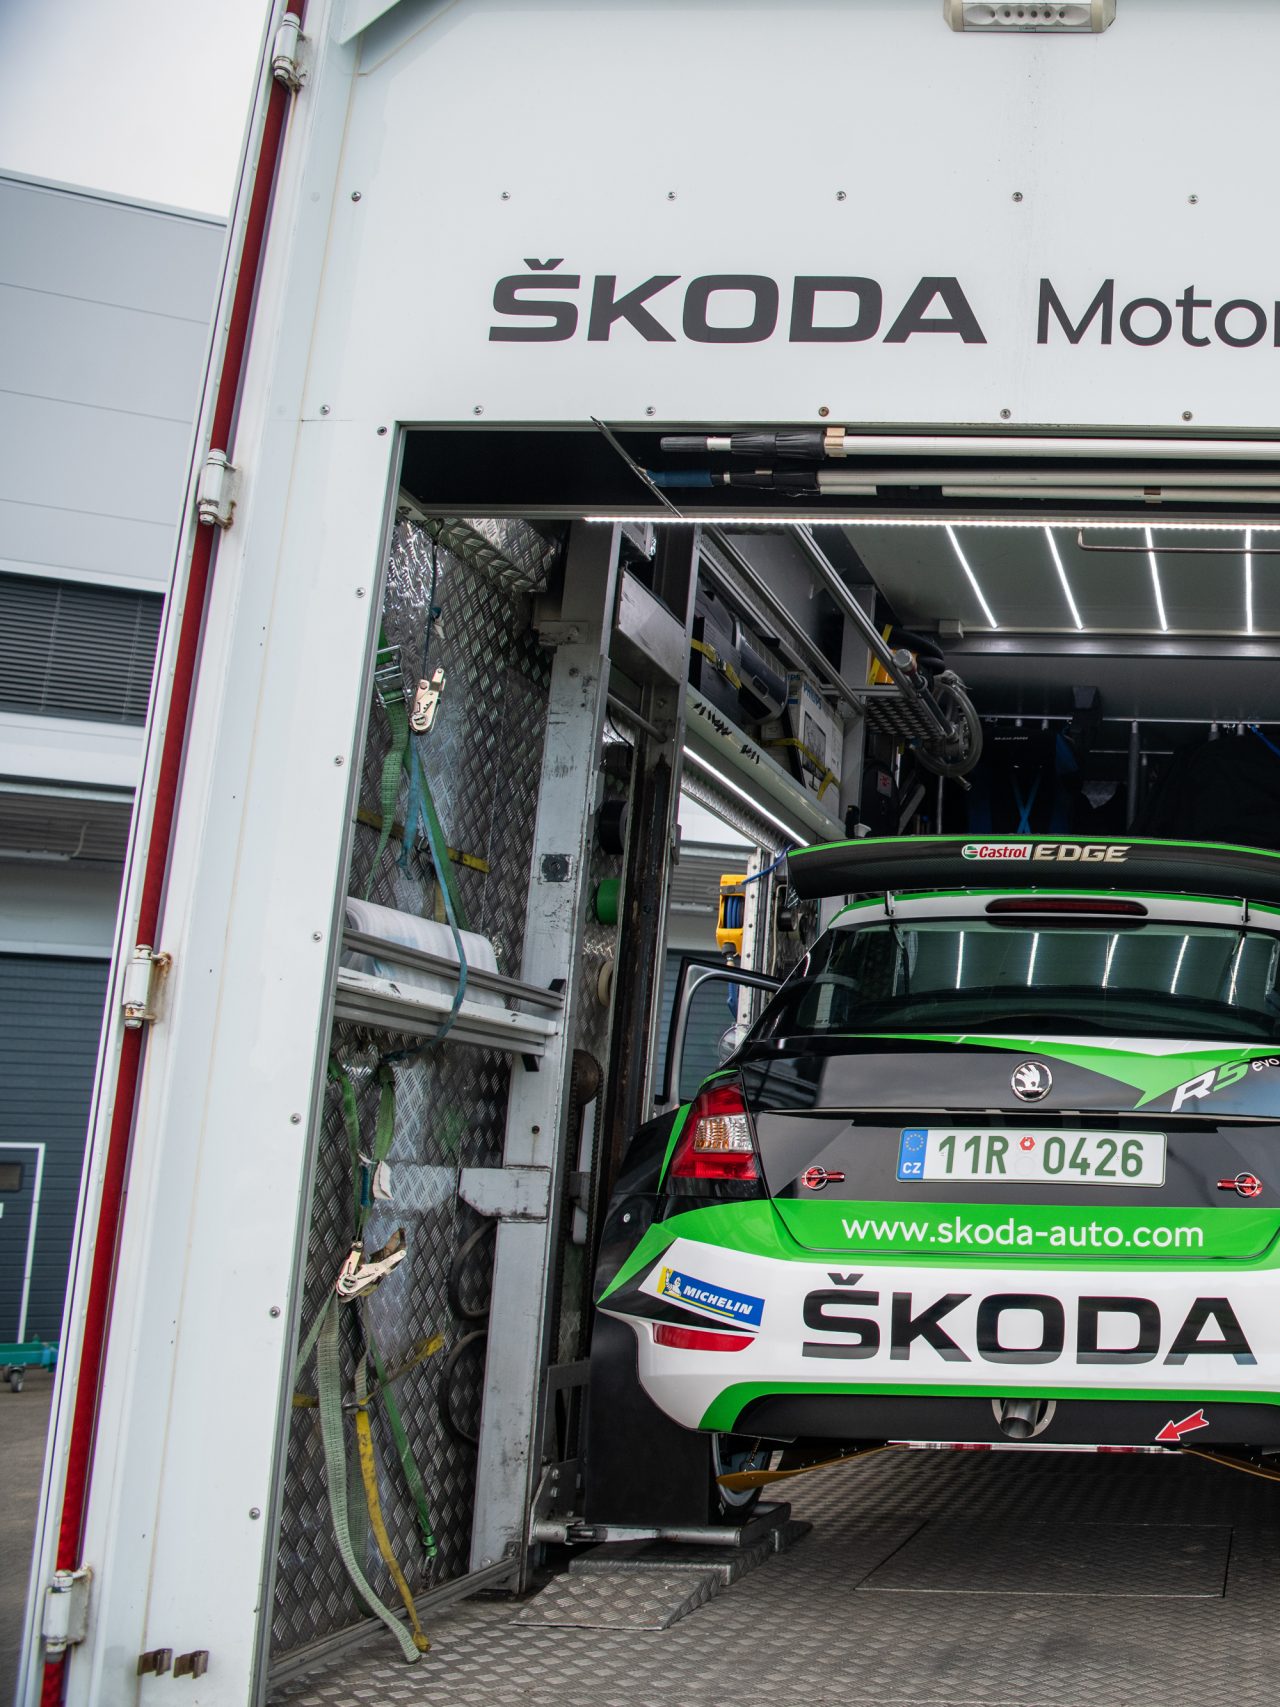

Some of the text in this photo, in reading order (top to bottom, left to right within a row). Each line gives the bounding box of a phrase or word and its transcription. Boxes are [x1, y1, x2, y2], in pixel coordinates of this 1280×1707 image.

[488, 258, 988, 344] ŠKODA
[979, 844, 1132, 863] Castrol EDGE
[1171, 1058, 1280, 1113] R5 evo
[902, 1162, 922, 1174] CZ
[938, 1135, 1144, 1178] 11R 0426
[841, 1216, 1204, 1248] www.skoda-auto.com
[683, 1285, 753, 1315] MICHELIN
[802, 1272, 1258, 1366] ŠKODA
